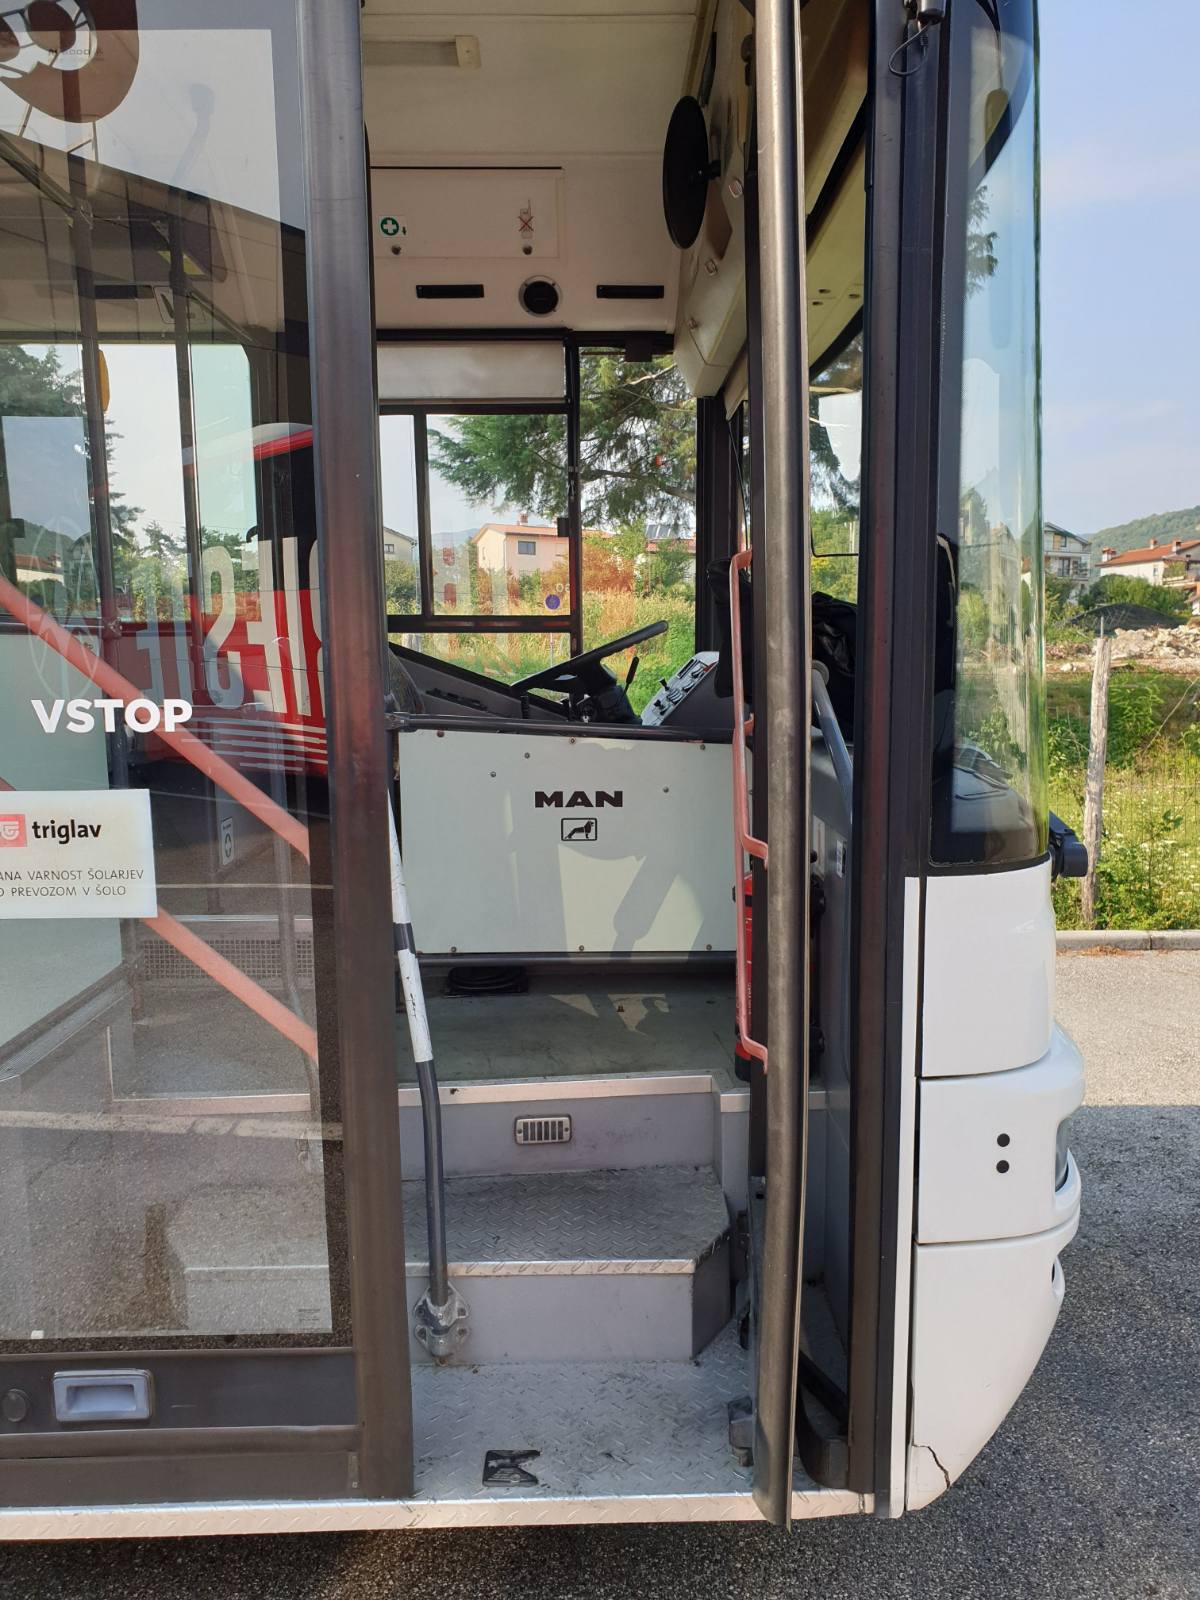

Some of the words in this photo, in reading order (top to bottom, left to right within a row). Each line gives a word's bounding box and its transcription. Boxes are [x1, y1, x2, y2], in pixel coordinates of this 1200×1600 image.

[31, 698, 193, 733] VSTOP
[535, 790, 623, 808] MAN
[31, 819, 102, 845] triglav
[27, 870, 83, 881] VARNOST
[87, 867, 144, 880] ŠOLARJEV
[11, 886, 77, 897] PREVOZOM
[82, 886, 91, 896] V
[95, 883, 126, 896] ŠOLO
